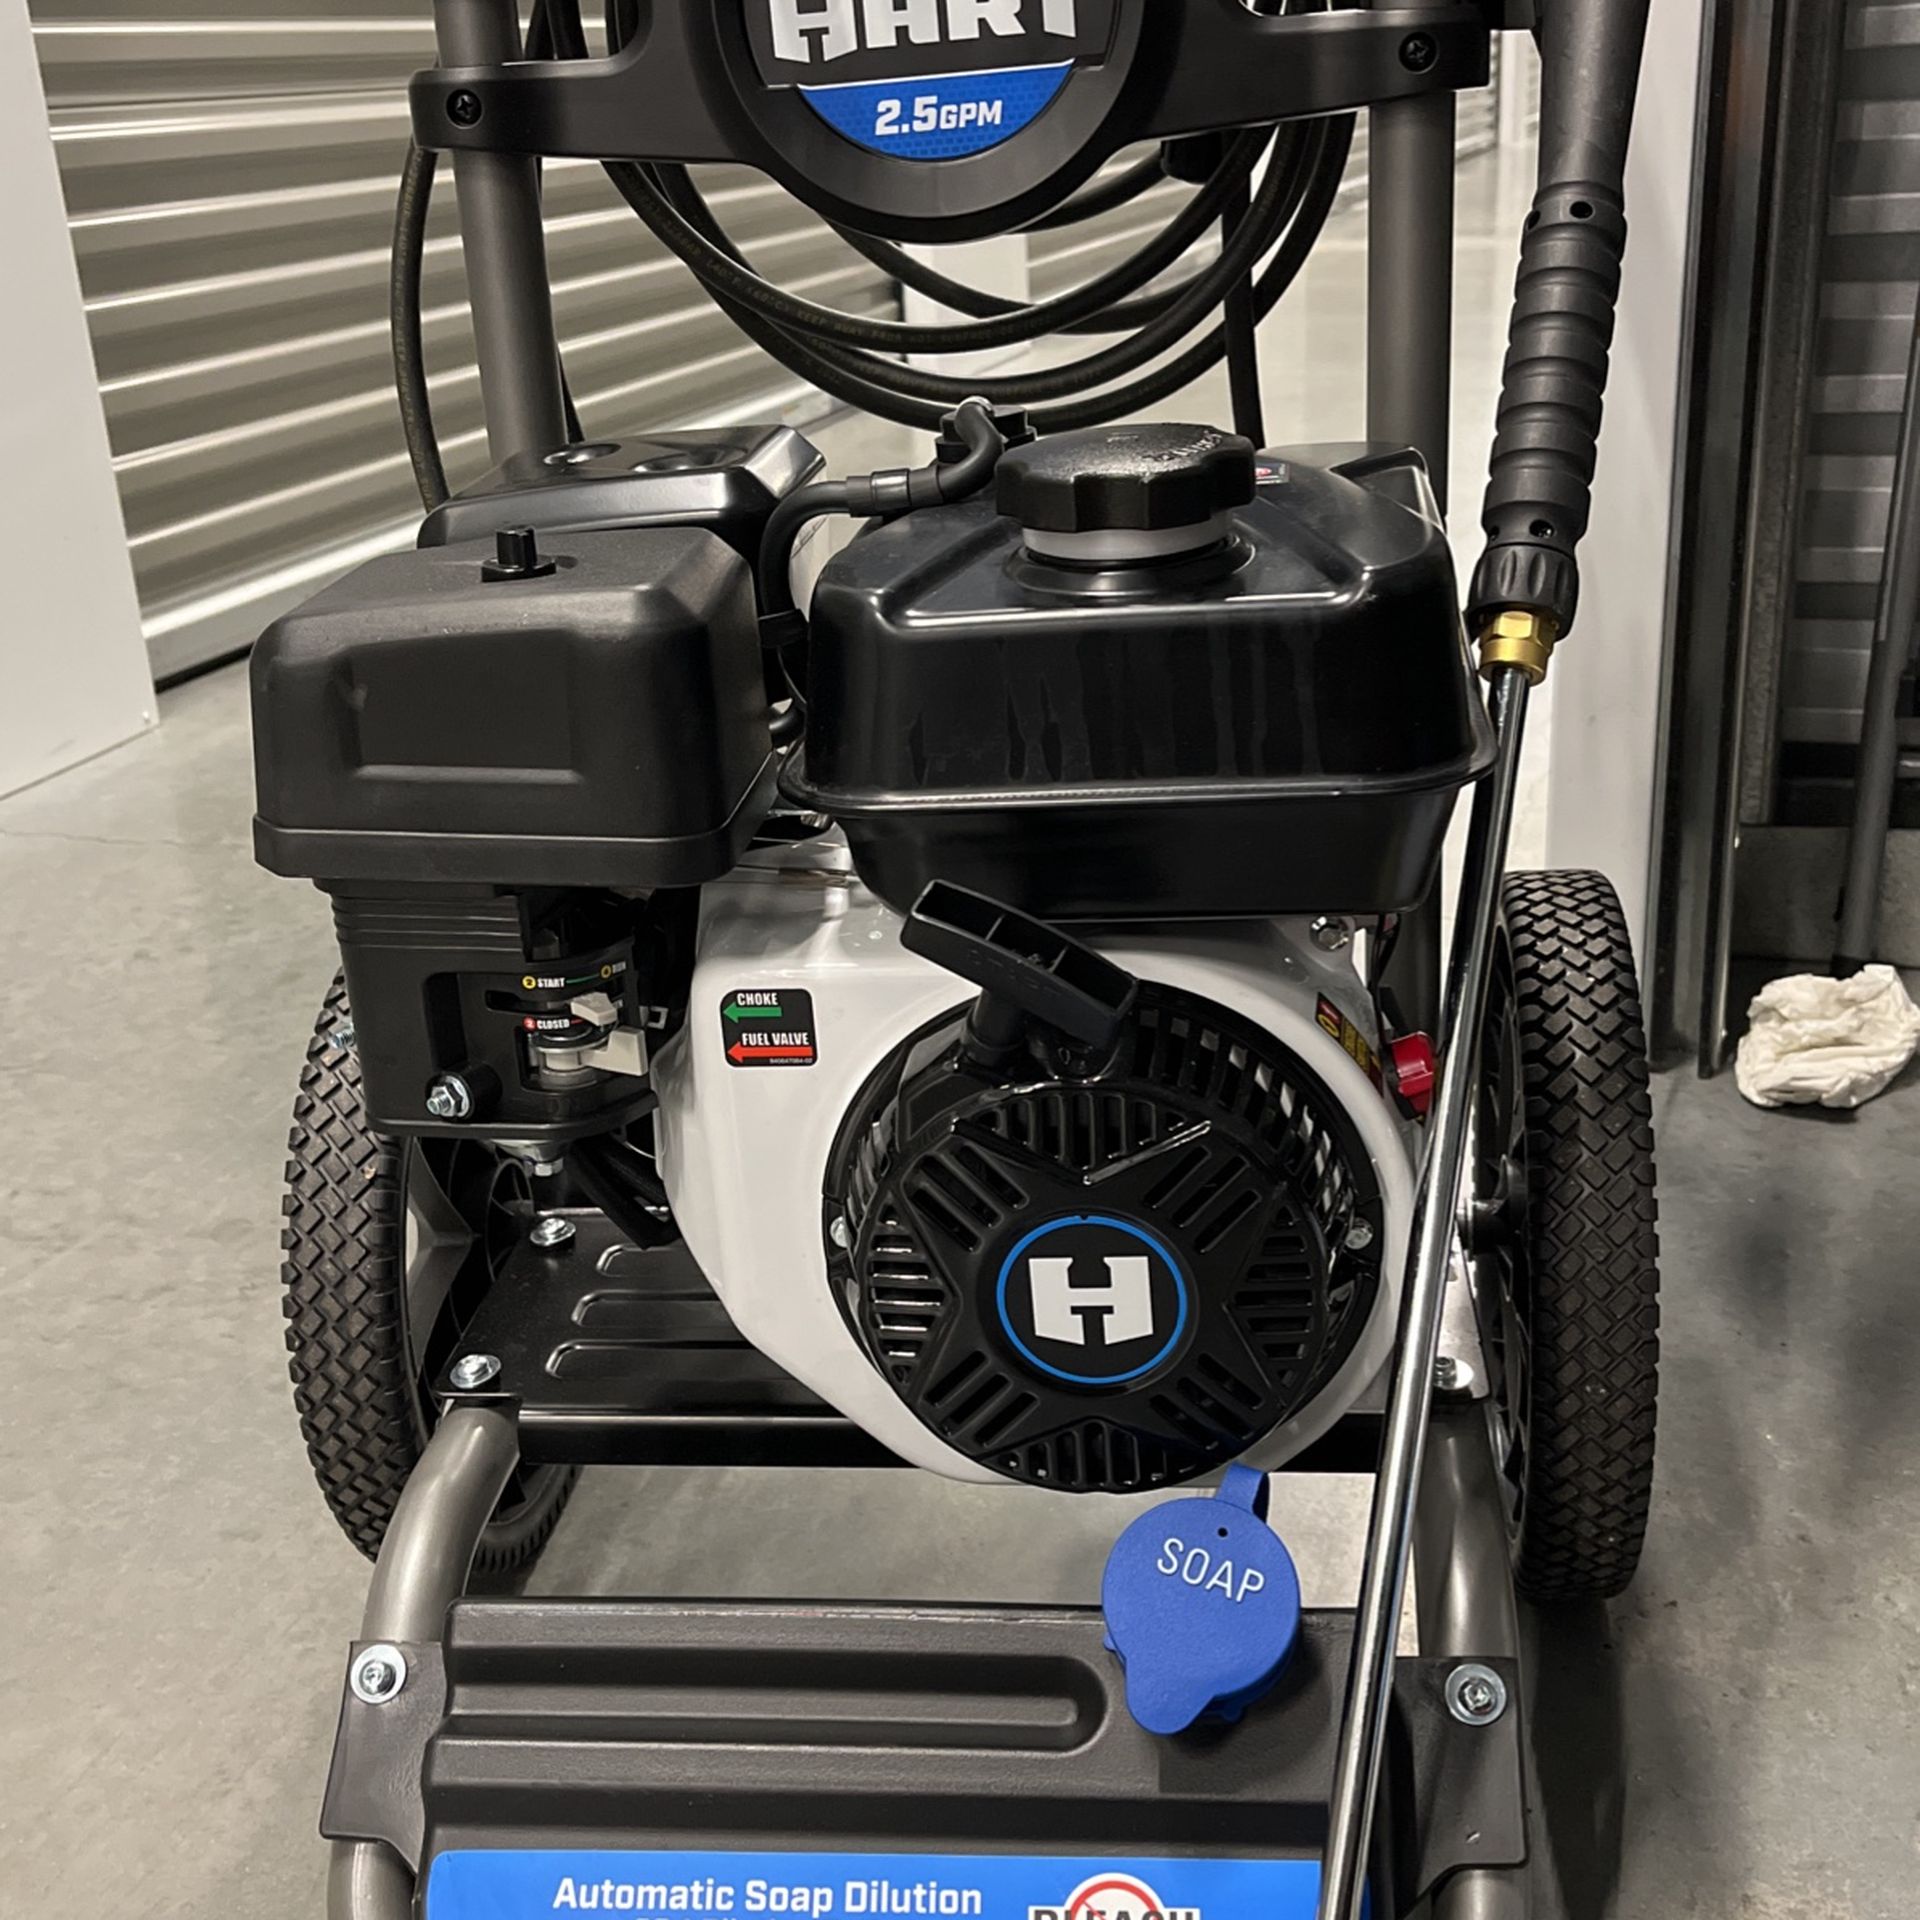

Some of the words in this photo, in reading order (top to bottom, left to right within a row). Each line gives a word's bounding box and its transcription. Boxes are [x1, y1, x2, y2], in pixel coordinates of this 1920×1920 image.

[537, 977, 565, 988] START
[737, 992, 779, 1006] CHOKE
[537, 1019, 570, 1030] CLOSED
[741, 1032, 770, 1046] FUEL
[771, 1032, 810, 1046] VALVE
[1028, 1256, 1153, 1345] H
[1157, 1537, 1265, 1603] SOAP
[553, 1877, 735, 1910] Automatic
[745, 1880, 833, 1919] Soap
[844, 1881, 982, 1914] Dilution
